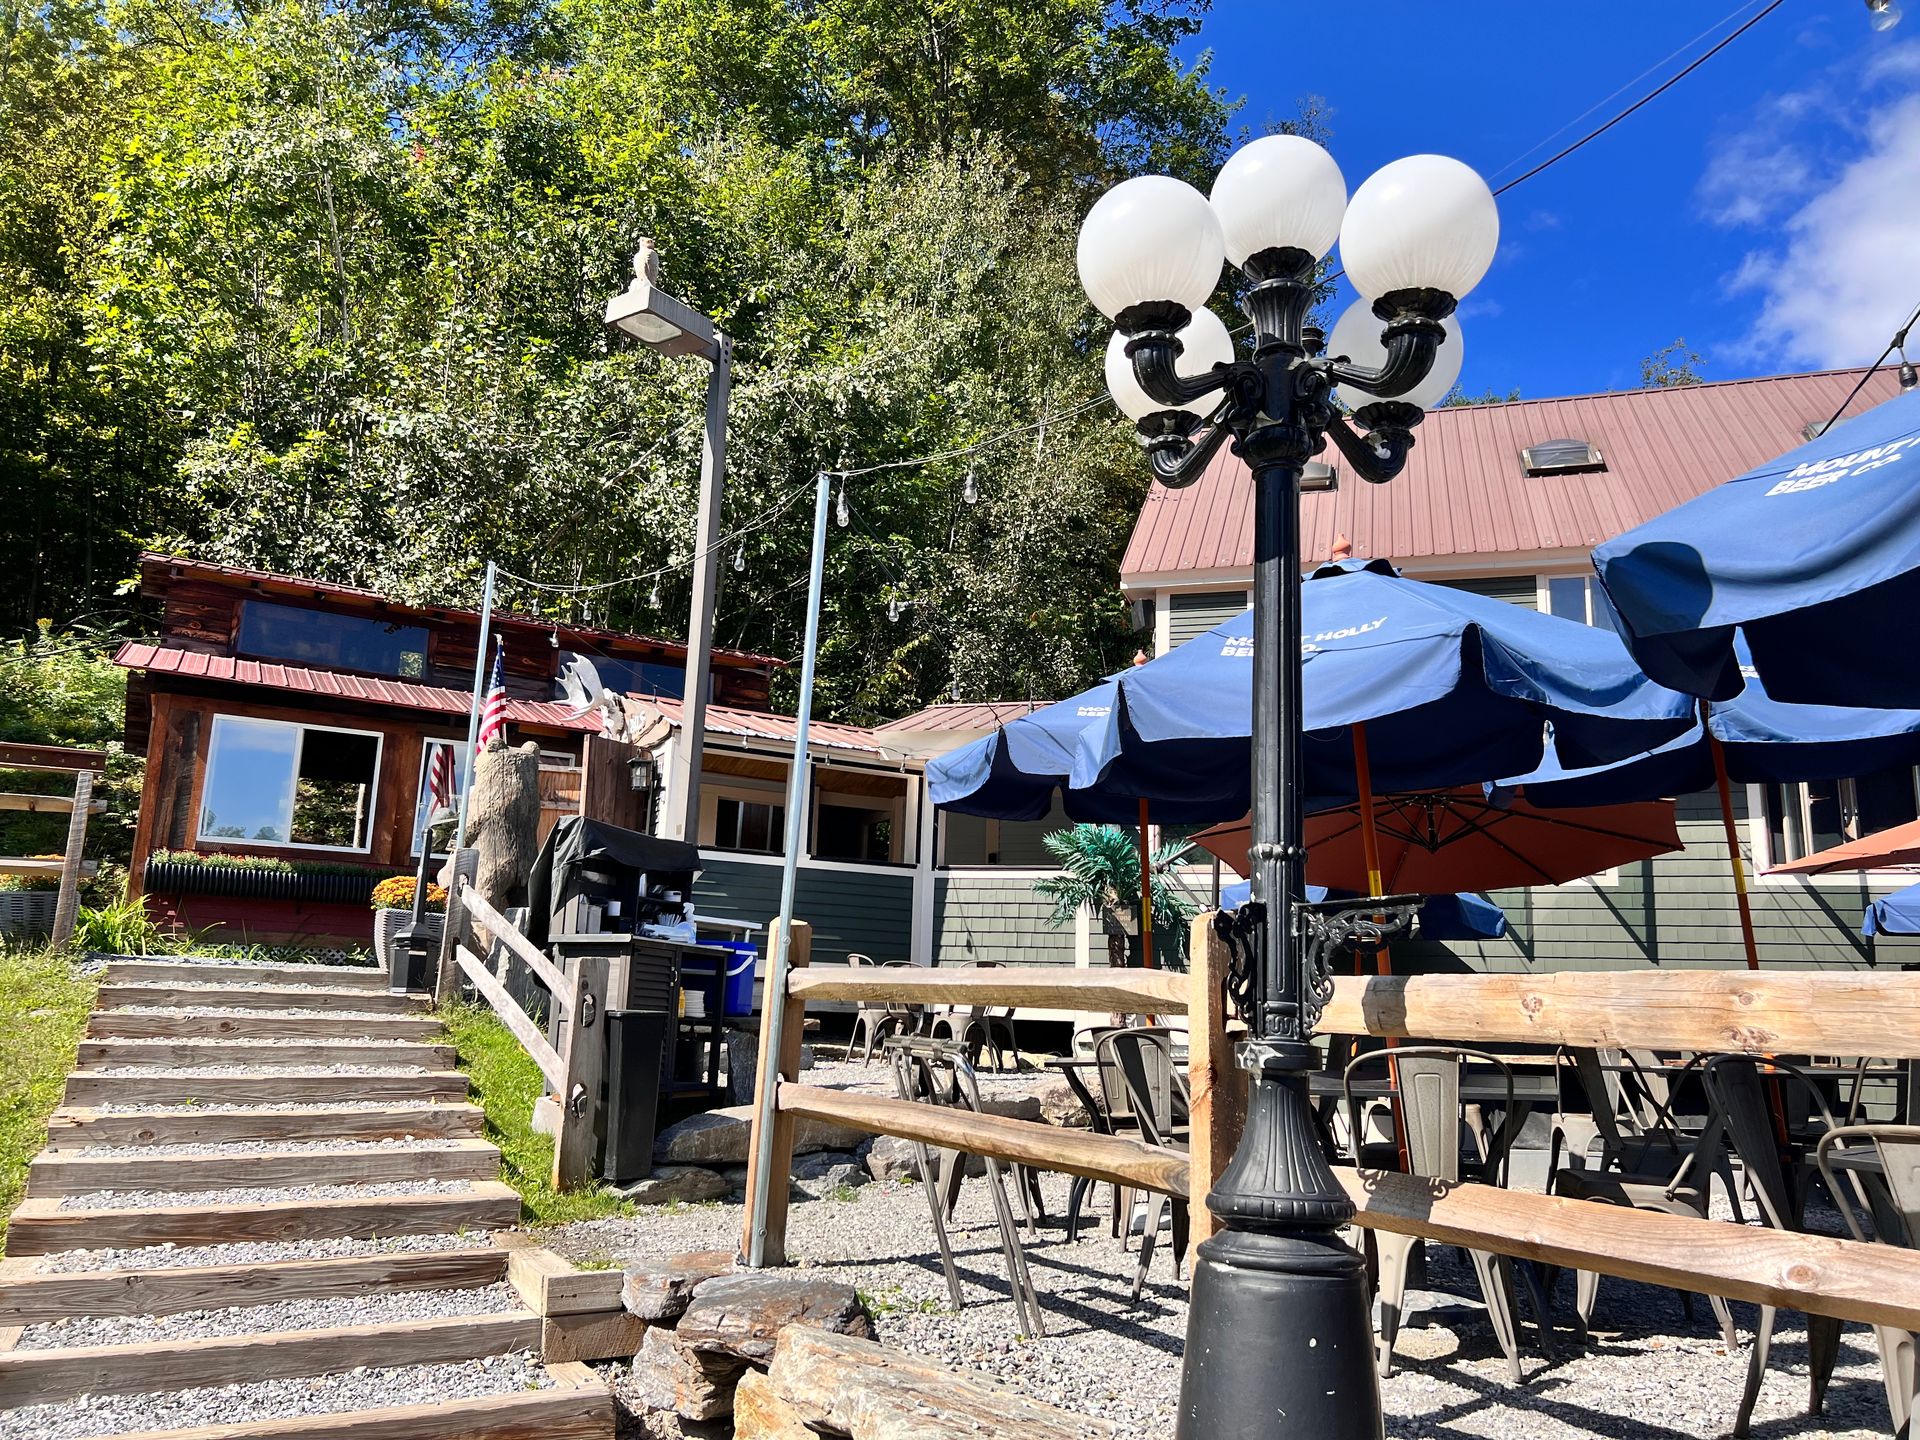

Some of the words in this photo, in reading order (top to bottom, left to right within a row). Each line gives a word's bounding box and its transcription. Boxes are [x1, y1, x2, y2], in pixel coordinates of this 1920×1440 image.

[1786, 437, 1914, 478] MOUNT
[1764, 469, 1850, 496] BEER
[1314, 617, 1387, 642] HOLLY
